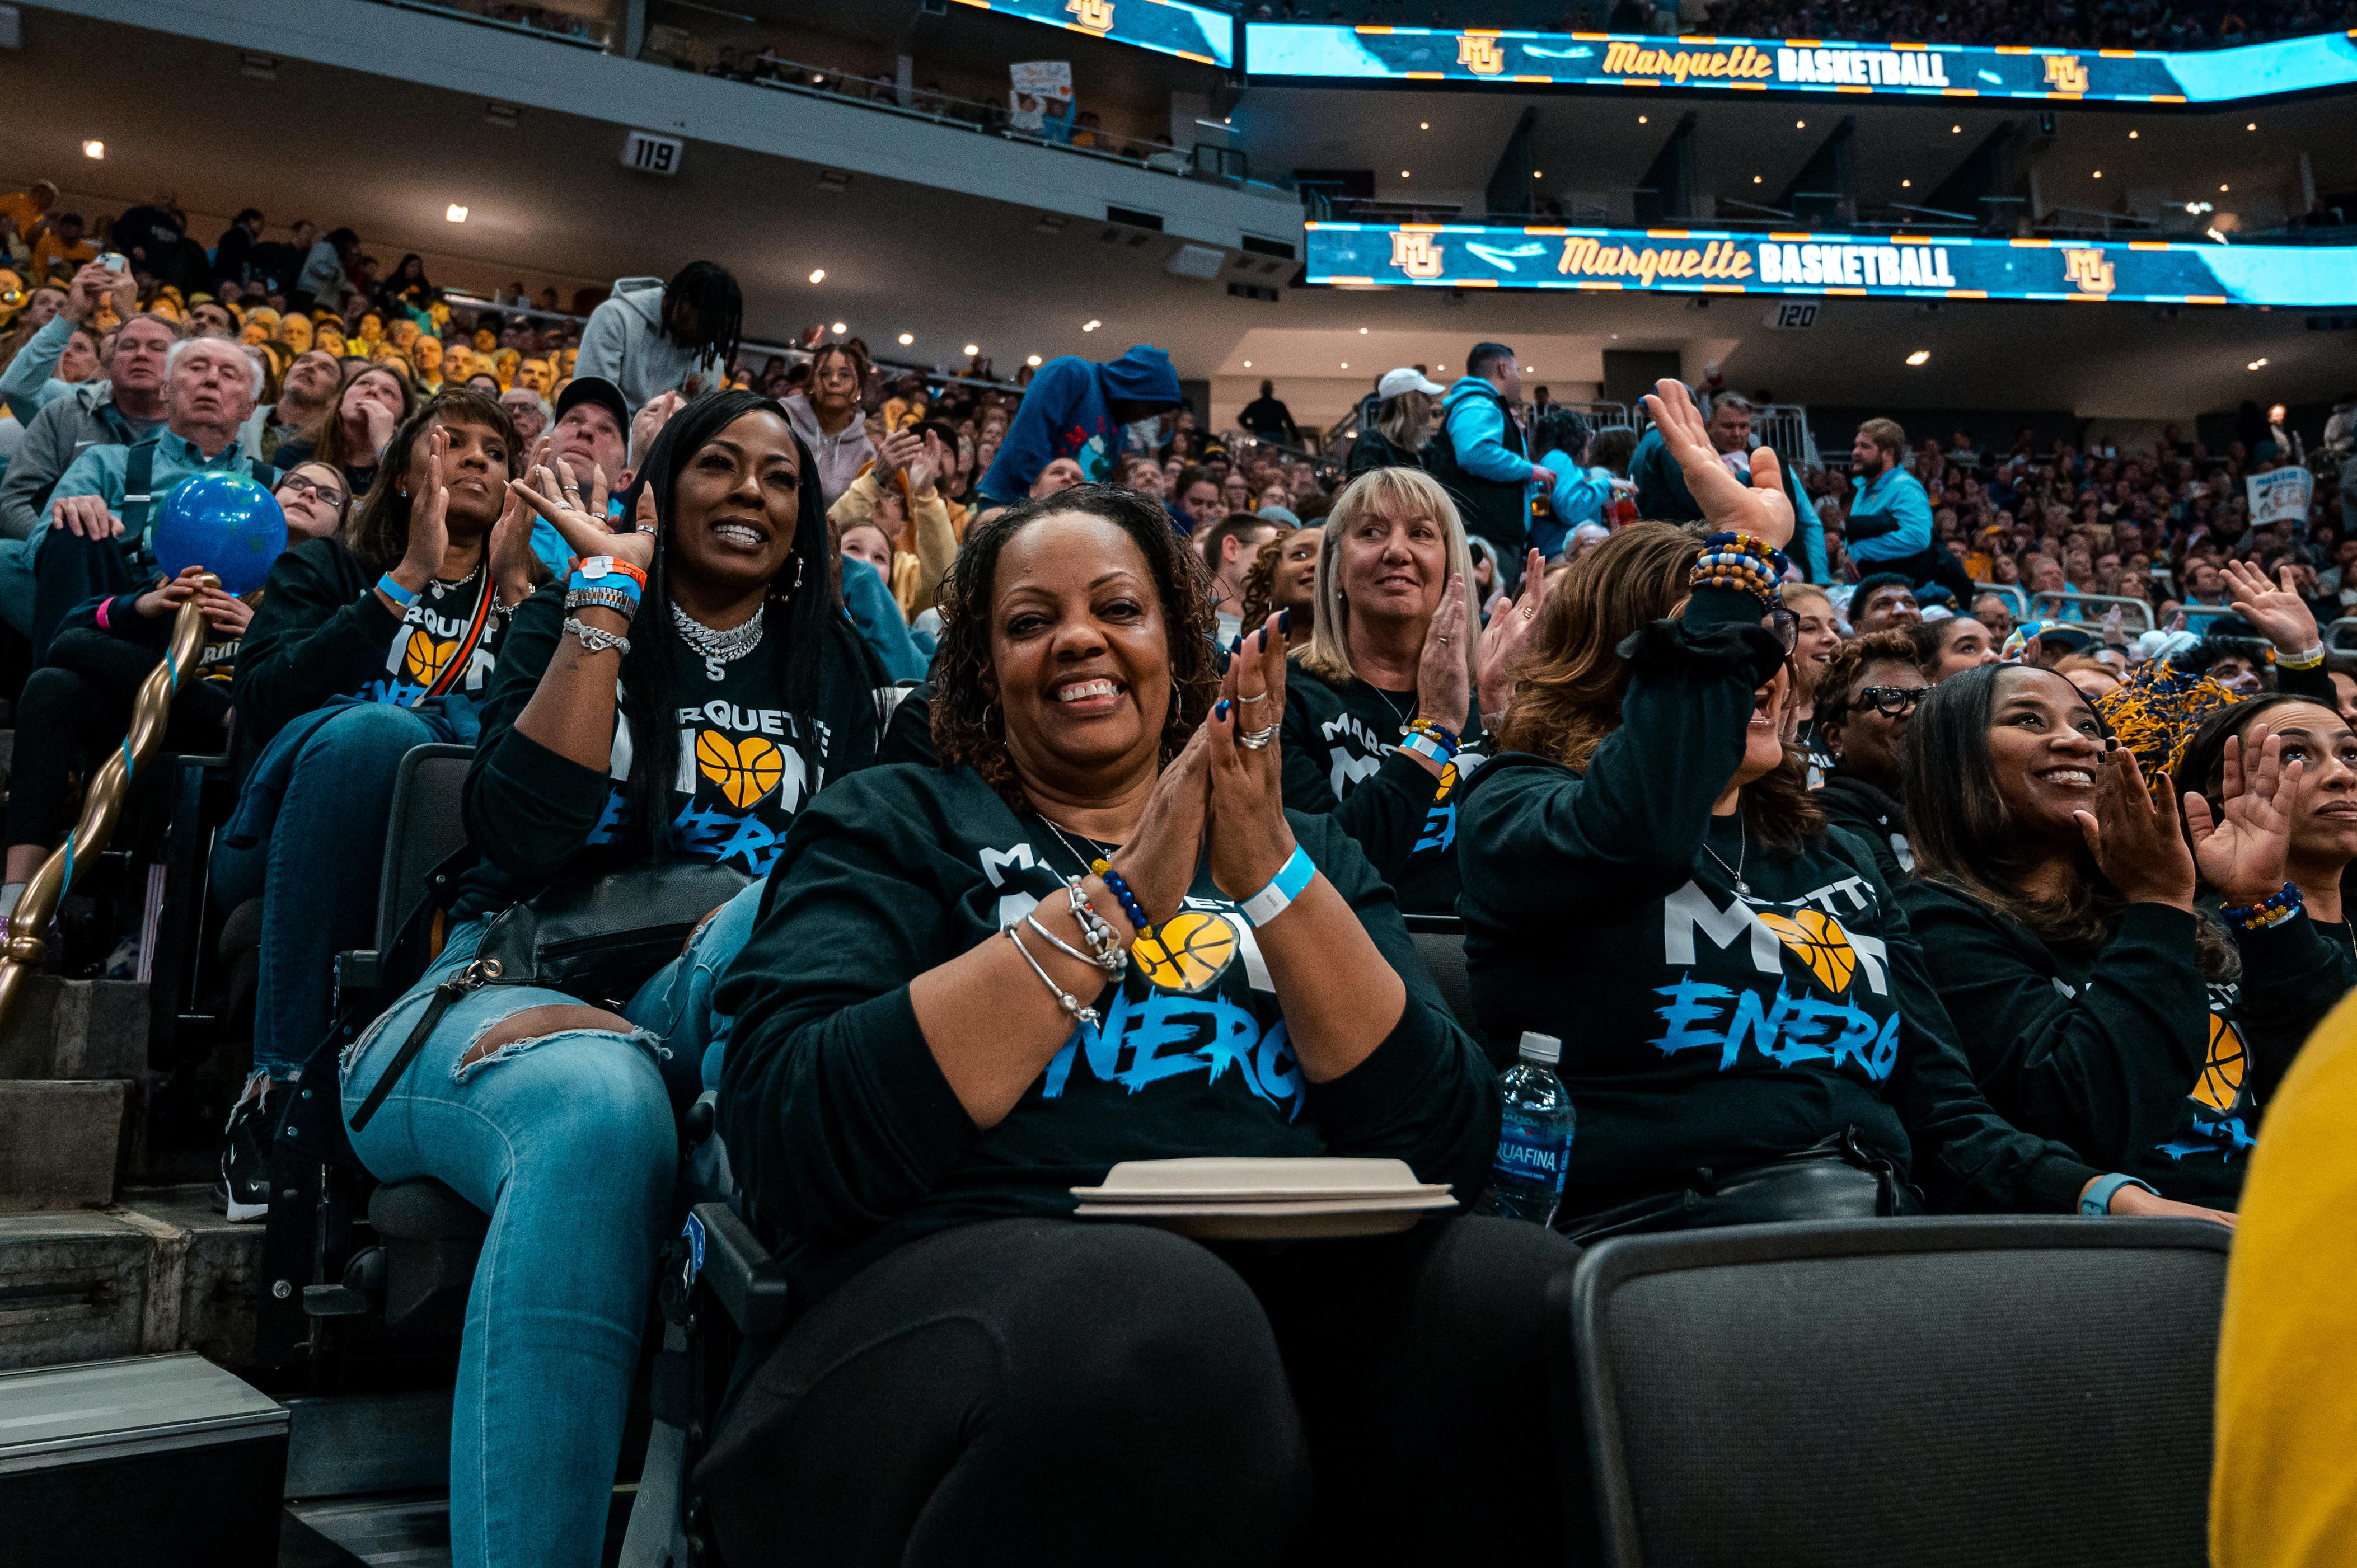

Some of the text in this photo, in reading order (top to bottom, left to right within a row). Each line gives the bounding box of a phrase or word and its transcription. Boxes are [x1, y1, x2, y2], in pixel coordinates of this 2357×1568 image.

[1456, 35, 2089, 93] MU Marquette BASKETBALL MU
[636, 139, 675, 171] 119
[1389, 231, 2116, 294] MU Marquette BASKETBALL MU
[1778, 305, 1817, 327] 120
[1646, 971, 1900, 1081] ENERG
